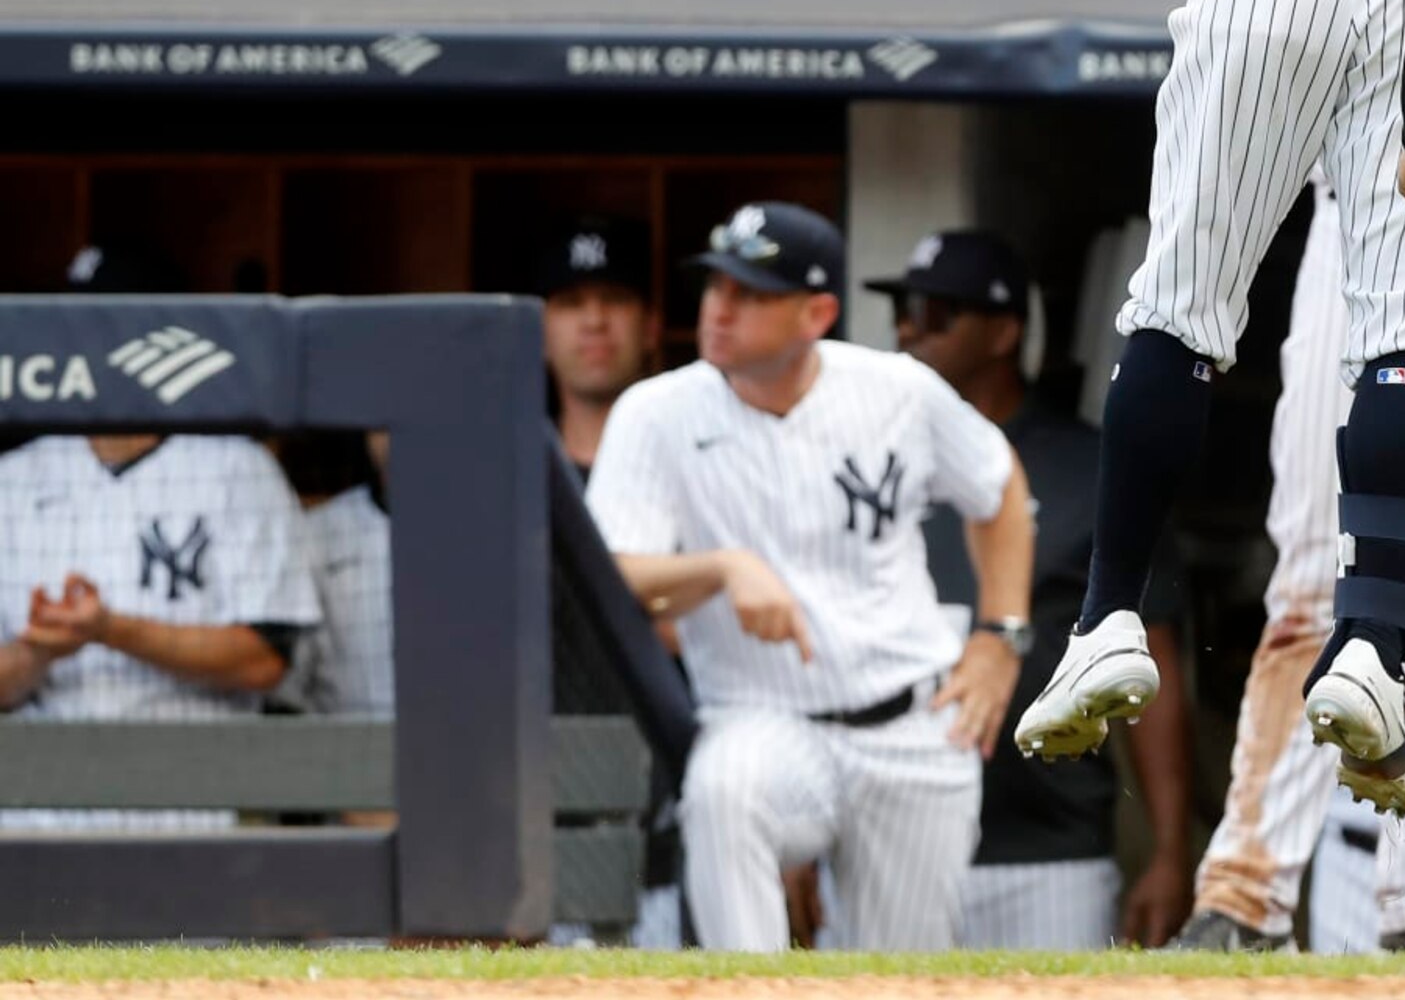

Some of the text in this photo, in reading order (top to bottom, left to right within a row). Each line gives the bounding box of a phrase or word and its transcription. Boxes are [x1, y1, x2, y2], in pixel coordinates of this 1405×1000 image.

[69, 43, 368, 74] BANK OF AMERICA
[566, 46, 865, 78] BANK OF AMERICA
[1079, 52, 1170, 81] BANK
[833, 450, 905, 542] NY
[138, 515, 211, 600] NY
